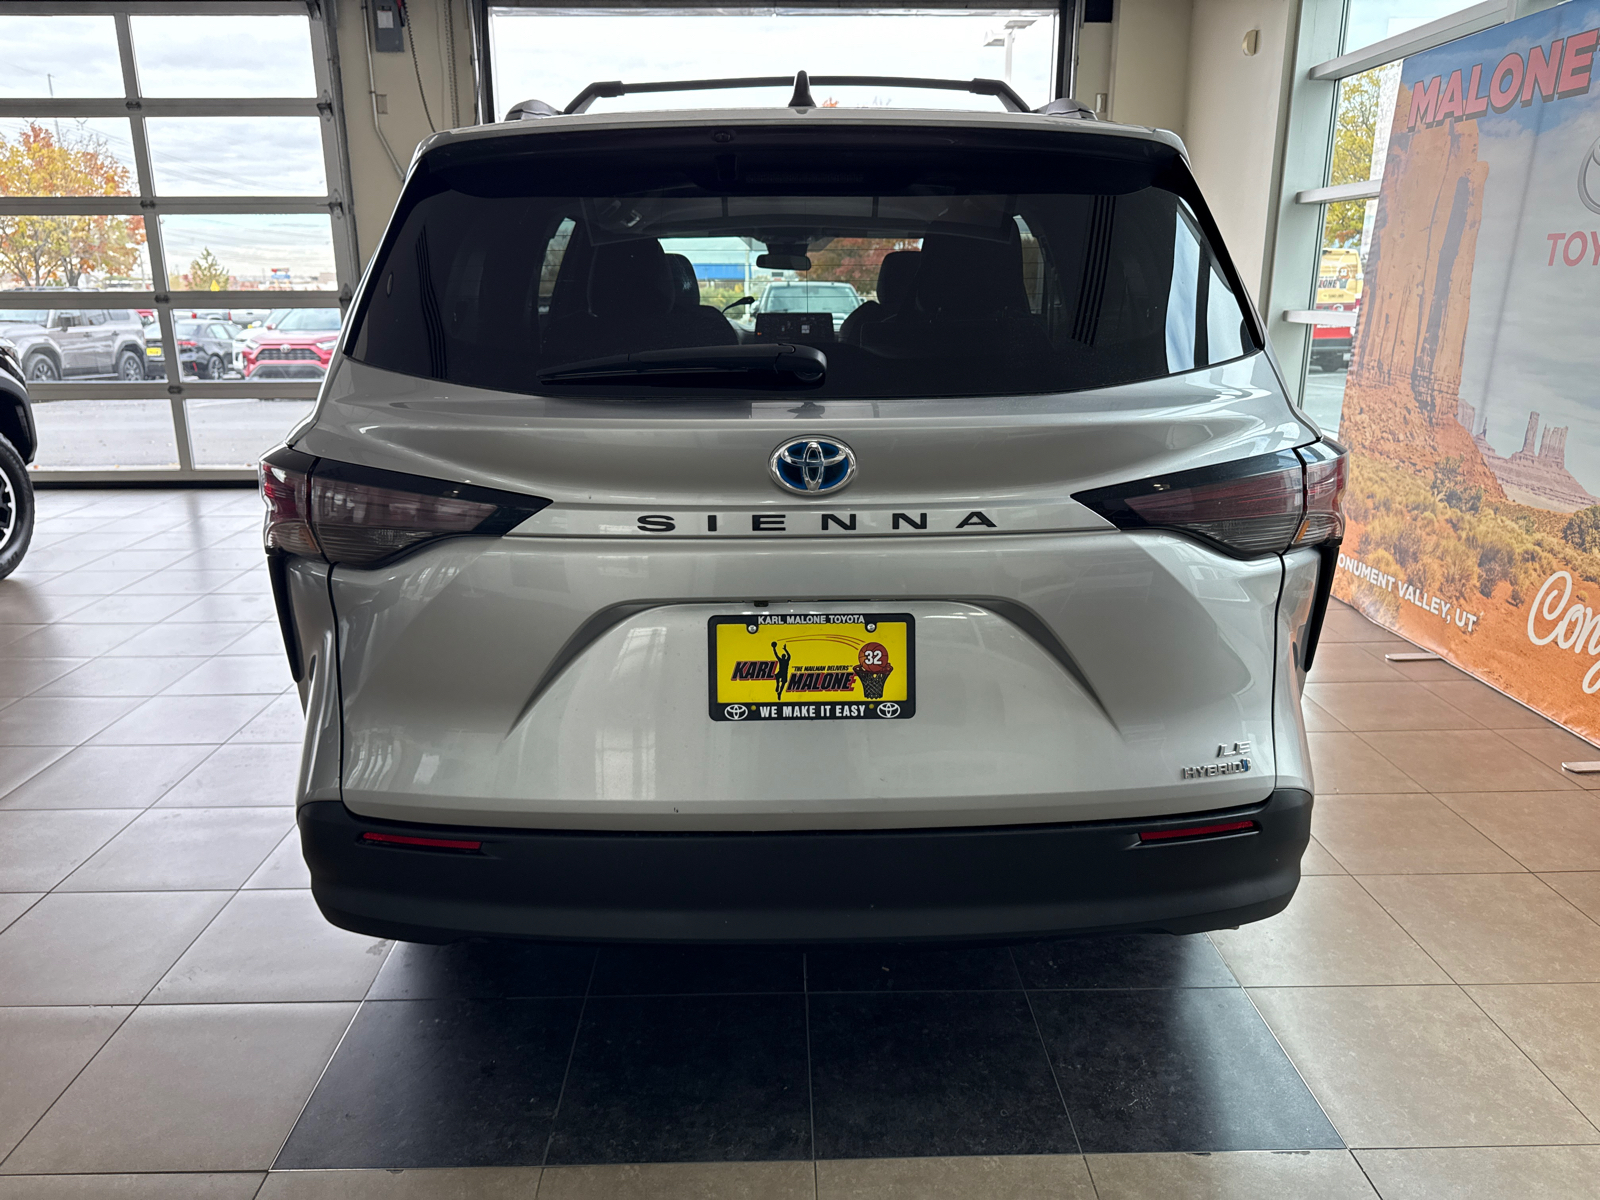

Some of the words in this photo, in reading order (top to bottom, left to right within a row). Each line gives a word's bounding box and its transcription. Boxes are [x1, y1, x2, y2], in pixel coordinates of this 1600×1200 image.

[1407, 28, 1600, 132] MALONE
[637, 511, 998, 532] SIENNA
[1338, 553, 1396, 592] ONUMENT
[1398, 580, 1451, 624] VALLEY,
[1455, 610, 1477, 632] UT
[758, 615, 784, 624] KARL
[786, 615, 827, 624] MALONE
[829, 615, 865, 624] TOYOTA
[1528, 571, 1600, 694] Con
[864, 650, 882, 665] 32
[731, 661, 778, 681] KARL
[786, 672, 857, 692] MALONE
[760, 706, 778, 718] WE
[783, 705, 816, 717] MAKE
[821, 705, 833, 717] IT
[836, 704, 866, 717] EASY
[1216, 741, 1252, 757] LE
[1182, 761, 1243, 779] HYBRID
